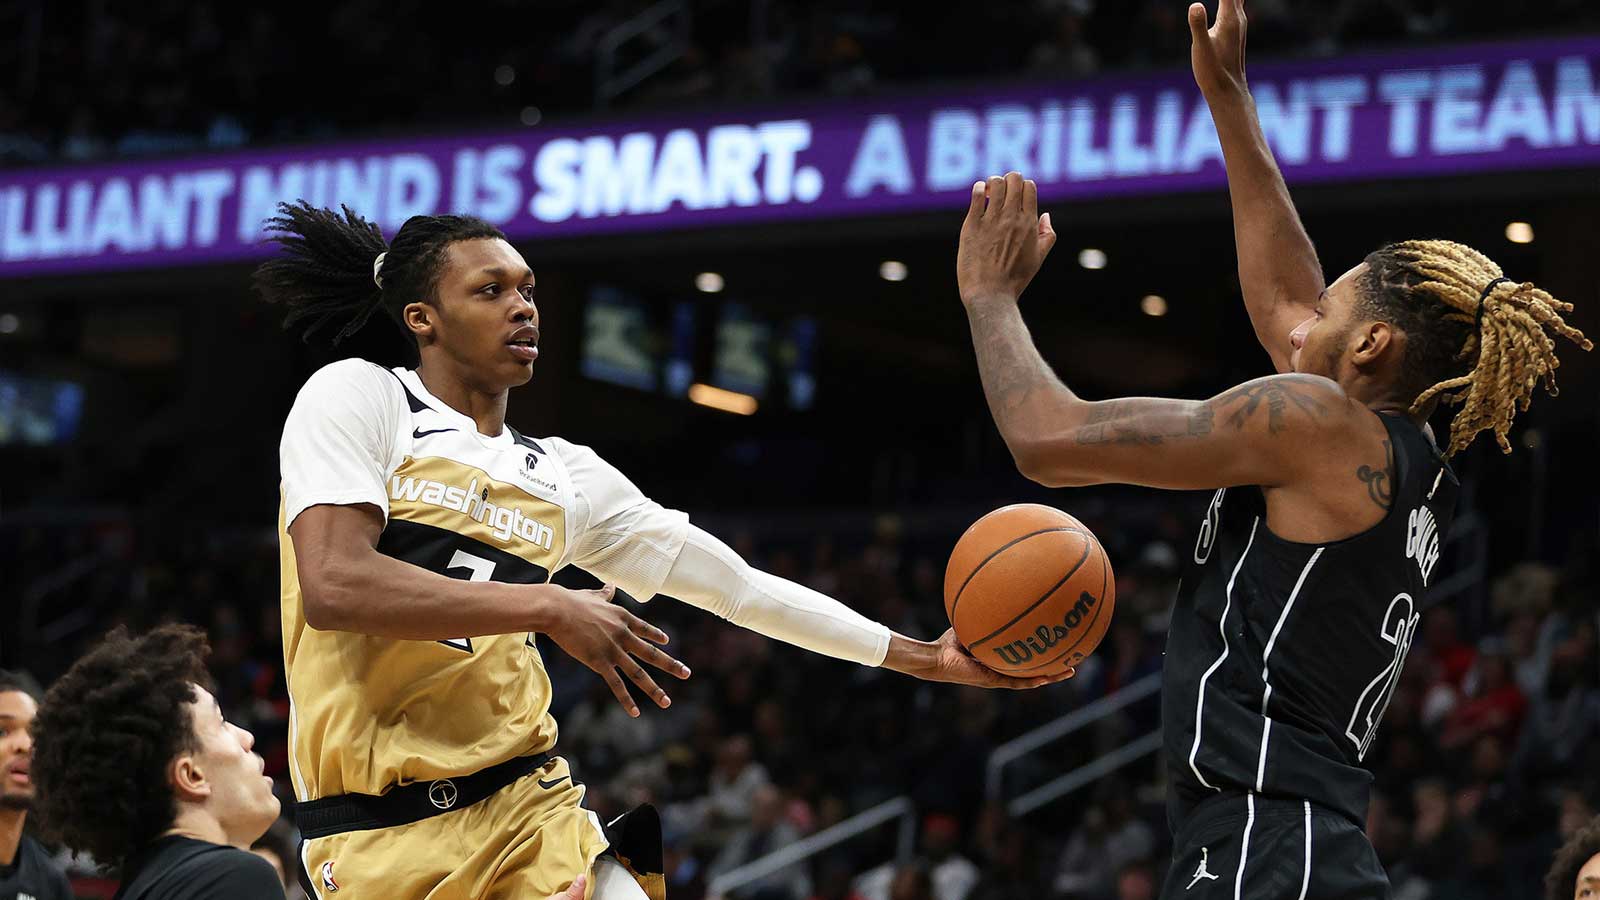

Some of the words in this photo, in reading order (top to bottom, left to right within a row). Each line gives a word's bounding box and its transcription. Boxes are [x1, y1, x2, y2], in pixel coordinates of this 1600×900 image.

[238, 153, 441, 244] MIND
[452, 144, 525, 224] IS
[529, 119, 823, 222] SMART.
[845, 113, 914, 198] A
[391, 474, 554, 551] washington
[993, 590, 1097, 666] Wilson
